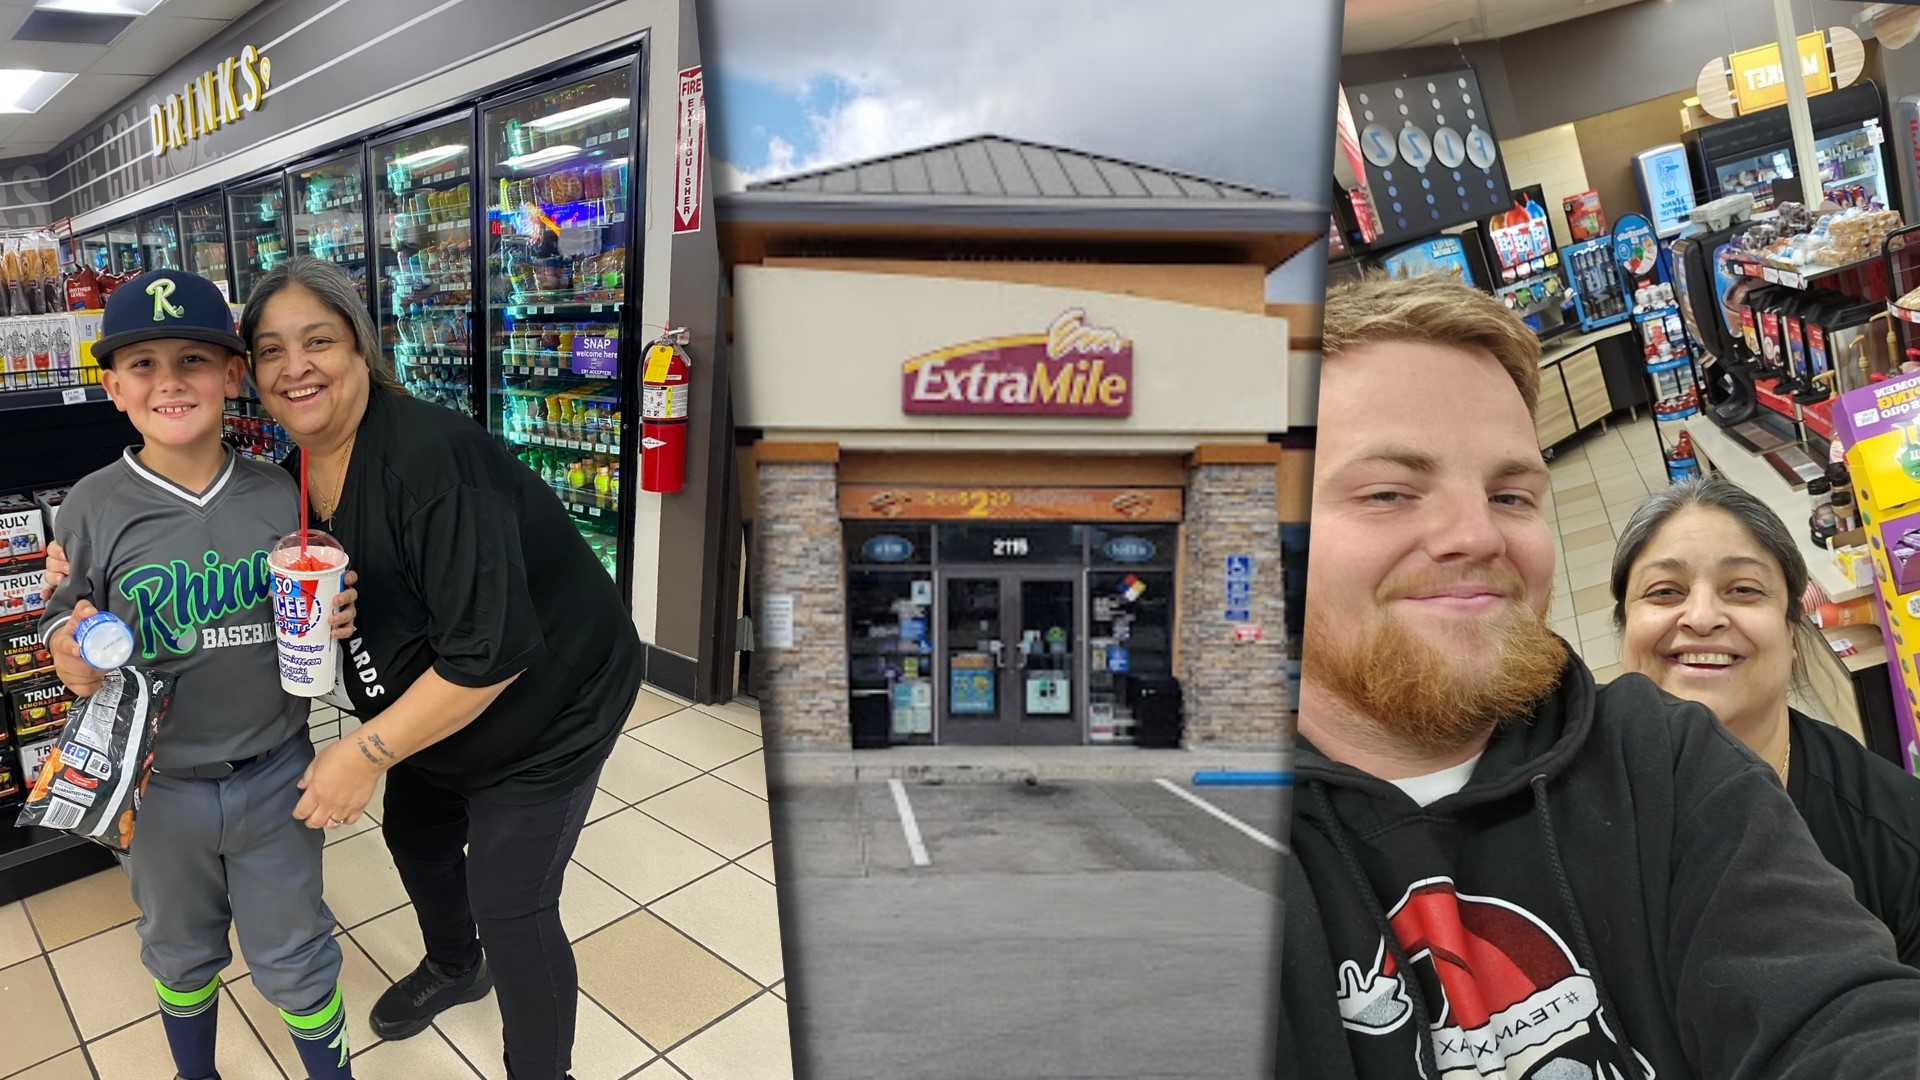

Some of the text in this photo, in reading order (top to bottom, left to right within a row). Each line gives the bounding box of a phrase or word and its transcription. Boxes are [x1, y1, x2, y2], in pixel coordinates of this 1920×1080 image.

[682, 78, 702, 96] FIRE
[150, 45, 262, 156] DRINKS
[683, 98, 695, 215] EXTINGUISHER
[66, 134, 100, 217] ICE
[145, 277, 185, 321] R
[584, 338, 611, 349] SNAP
[576, 350, 618, 359] welcome here
[1, 573, 43, 590] TRULY
[275, 577, 293, 594] 50
[3, 588, 25, 597] BERRY
[4, 644, 43, 656] LEMONADE
[349, 637, 385, 698] ARDS
[24, 685, 66, 702] TRULY
[19, 698, 57, 710] LEMONADE
